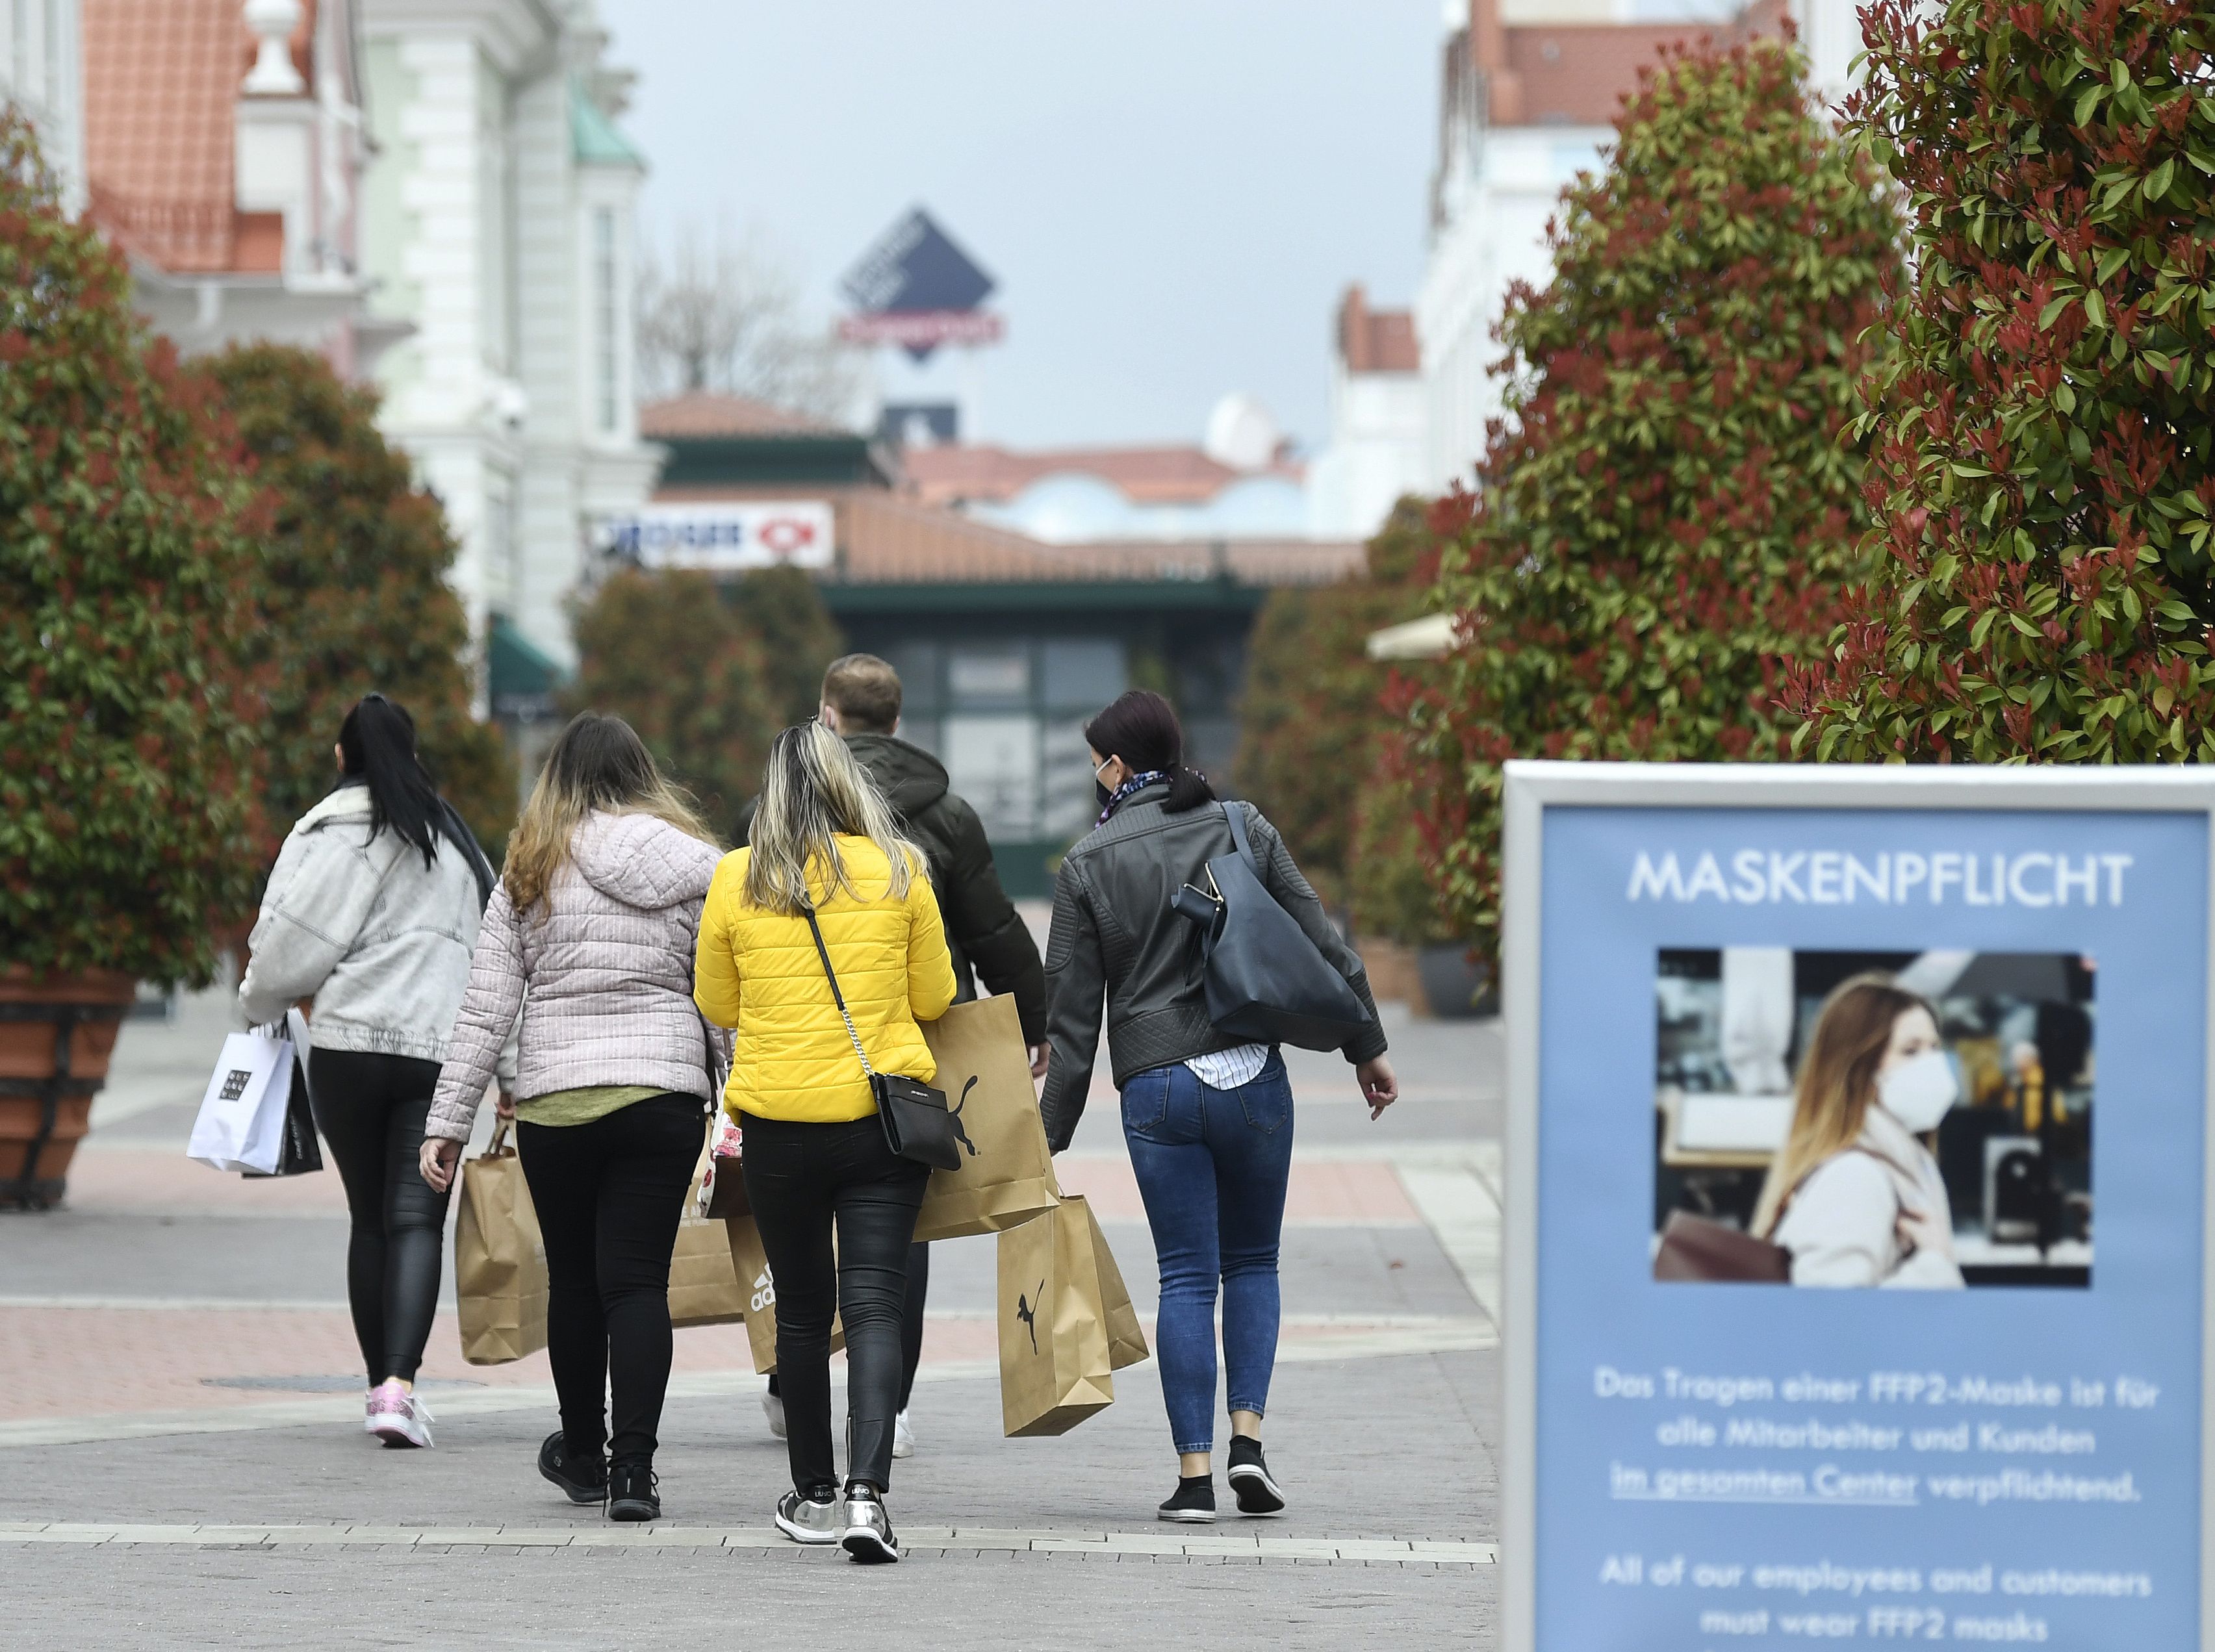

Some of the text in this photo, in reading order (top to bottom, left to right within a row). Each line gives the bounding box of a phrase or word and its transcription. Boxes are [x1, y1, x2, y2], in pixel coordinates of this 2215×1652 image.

[1626, 850, 2134, 906] MASKENPFLICHT
[1594, 1366, 2160, 1408] Das Tragen einer FFP2-Maske ist für
[1657, 1417, 2095, 1454] alle Mitarbeiter und Kunden
[1611, 1464, 2141, 1505] im gesamten Center verpflichtend.
[1601, 1556, 2153, 1597] All of our employees and customers
[1700, 1607, 2049, 1642] must wear FFP2 masks
